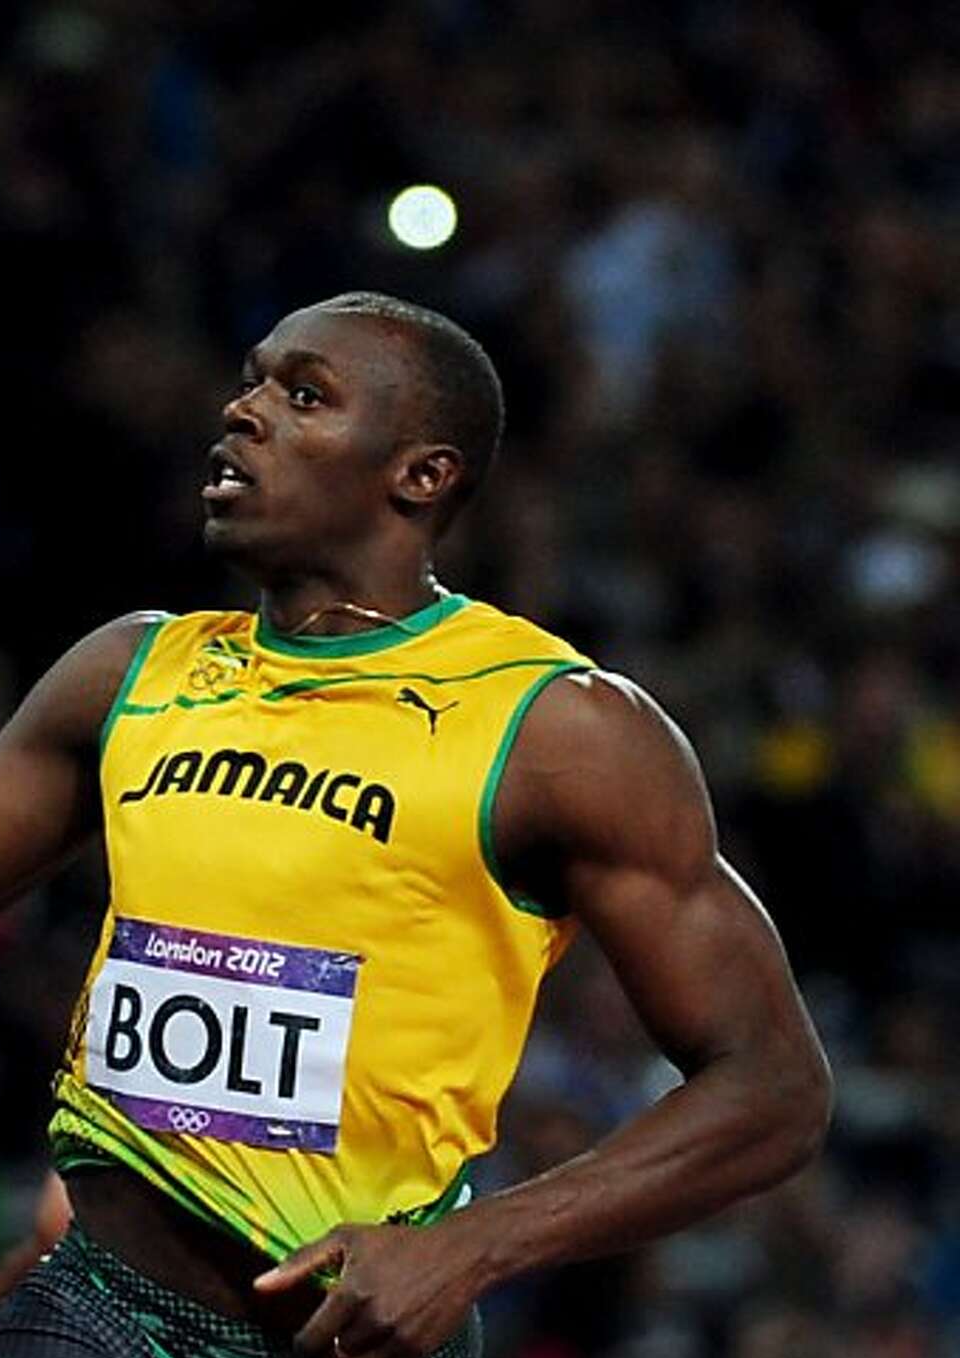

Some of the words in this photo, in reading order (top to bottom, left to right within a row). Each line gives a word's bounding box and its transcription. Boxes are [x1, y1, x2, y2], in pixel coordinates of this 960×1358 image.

[119, 748, 396, 844] JAMAICA
[144, 933, 222, 969] London
[226, 946, 286, 977] 2012
[104, 982, 321, 1099] BOLT
